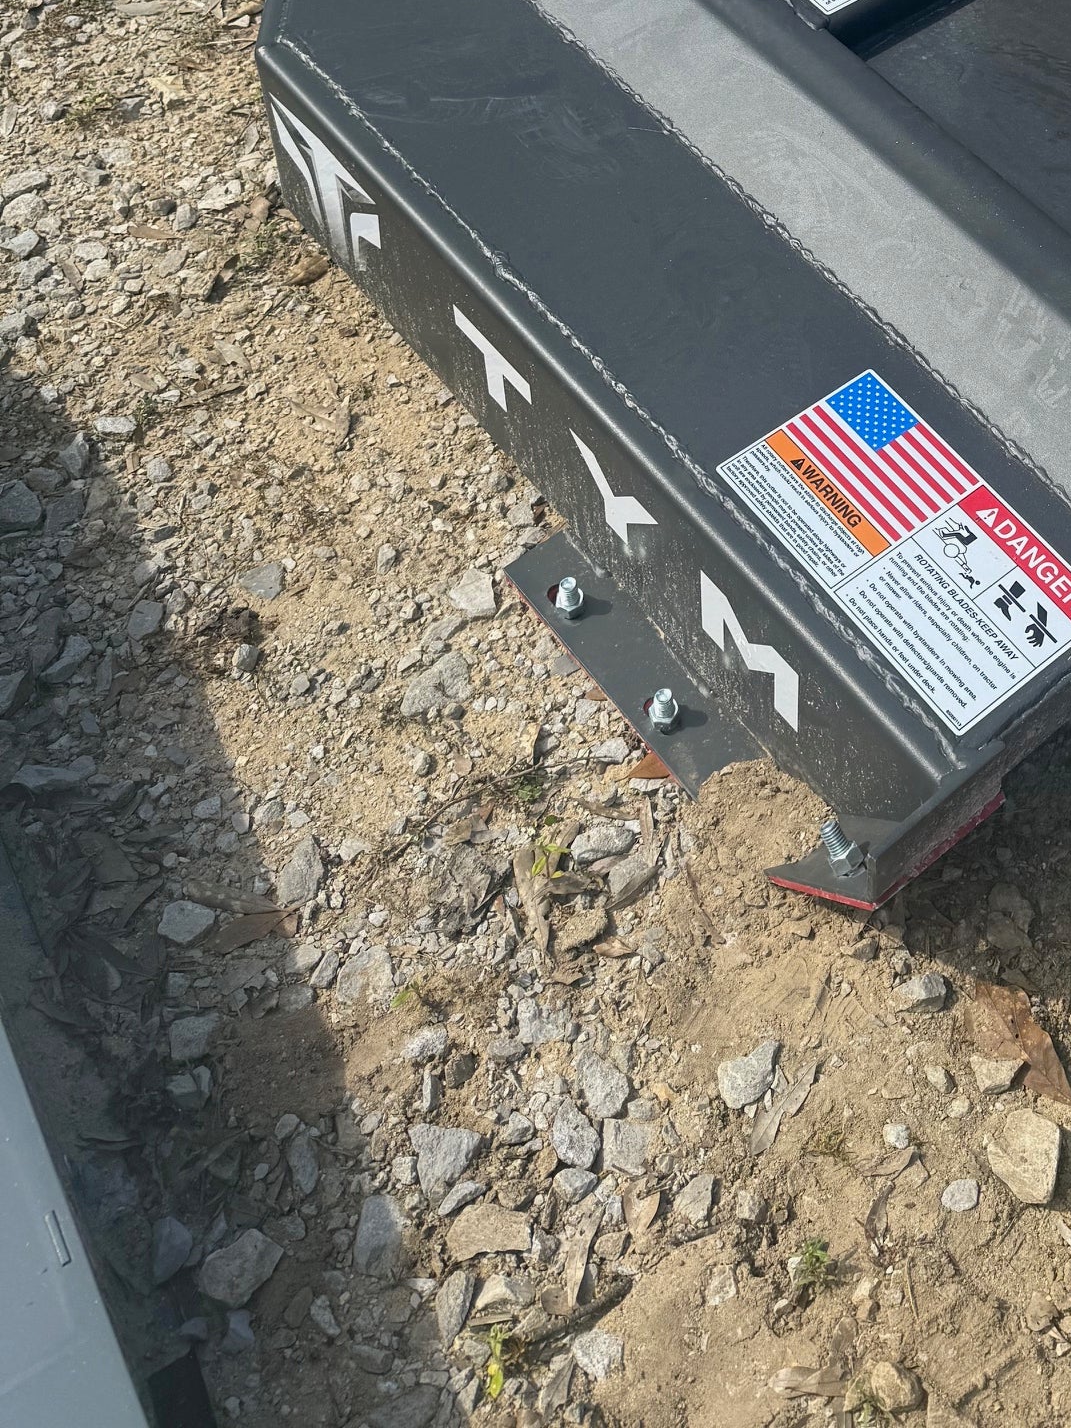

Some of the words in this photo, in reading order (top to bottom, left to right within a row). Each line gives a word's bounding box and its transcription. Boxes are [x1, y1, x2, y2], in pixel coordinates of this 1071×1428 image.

[801, 464, 862, 528] WARNING
[848, 597, 857, 607] Do
[855, 605, 866, 616] not
[862, 615, 878, 630] place
[876, 628, 893, 646] hands
[897, 651, 909, 664] feet
[907, 662, 923, 679] under
[921, 678, 935, 694] deck.
[858, 590, 867, 599] Do
[865, 598, 876, 609] not
[874, 607, 893, 627] operate
[892, 626, 904, 639] with
[902, 638, 944, 684] deflectors/guards
[943, 683, 967, 709] removed.
[868, 582, 877, 592] Do
[875, 591, 886, 601] not
[884, 600, 903, 620] operate
[902, 619, 914, 631] with
[912, 629, 940, 660] bystanders
[938, 658, 946, 666] in
[944, 665, 965, 688] mowing
[963, 686, 976, 701] area.
[885, 570, 901, 586] Never
[899, 585, 914, 600] allow
[911, 599, 927, 617] riders,
[927, 615, 952, 642] especially
[951, 641, 972, 665] children,
[972, 663, 980, 672] on
[979, 671, 997, 690] tractor
[888, 556, 908, 577] running
[906, 576, 918, 586] and
[916, 585, 925, 595] the
[924, 593, 941, 612] blades
[939, 611, 950, 620] are
[948, 619, 970, 642] rotating:
[895, 551, 903, 559] To
[900, 558, 921, 578] prevent
[919, 577, 938, 596] serious
[936, 595, 952, 611] injury
[956, 616, 972, 632] death
[970, 631, 985, 646] when
[983, 645, 994, 655] the
[992, 654, 1010, 674] engine
[1009, 672, 1016, 680] is
[913, 554, 950, 589] ROTATING
[947, 588, 998, 638] BLADES-KEEP
[994, 639, 1019, 660] AWAY
